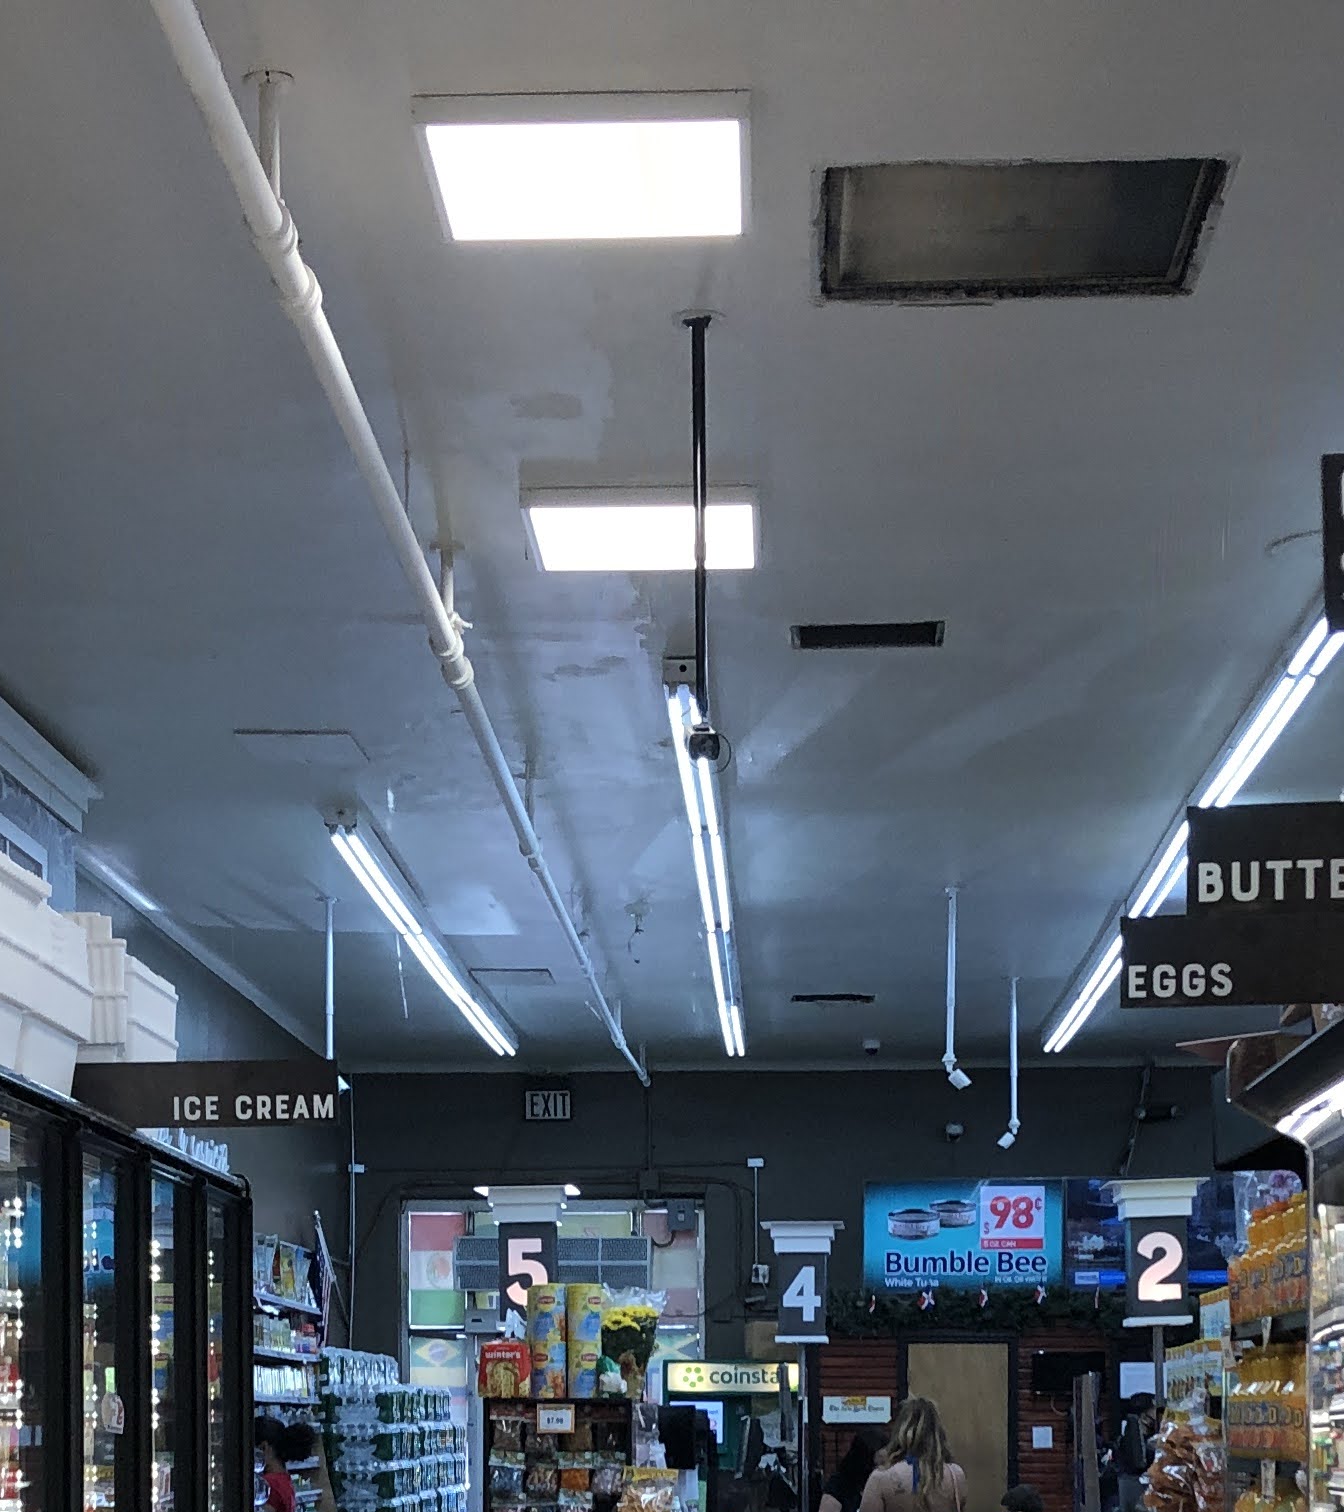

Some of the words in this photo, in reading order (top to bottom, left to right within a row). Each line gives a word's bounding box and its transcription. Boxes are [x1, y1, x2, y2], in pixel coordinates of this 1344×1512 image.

[1127, 962, 1234, 999] EGGS
[173, 1095, 219, 1122] ICE
[235, 1094, 336, 1121] CREAM
[529, 1092, 570, 1118] EXIT
[506, 1237, 549, 1307] 5
[885, 1250, 991, 1275] Bumble
[997, 1250, 1047, 1275] Bee
[1136, 1232, 1184, 1302] 2
[782, 1265, 823, 1323] 4
[885, 1277, 913, 1288] White
[709, 1364, 779, 1386] coinsta
